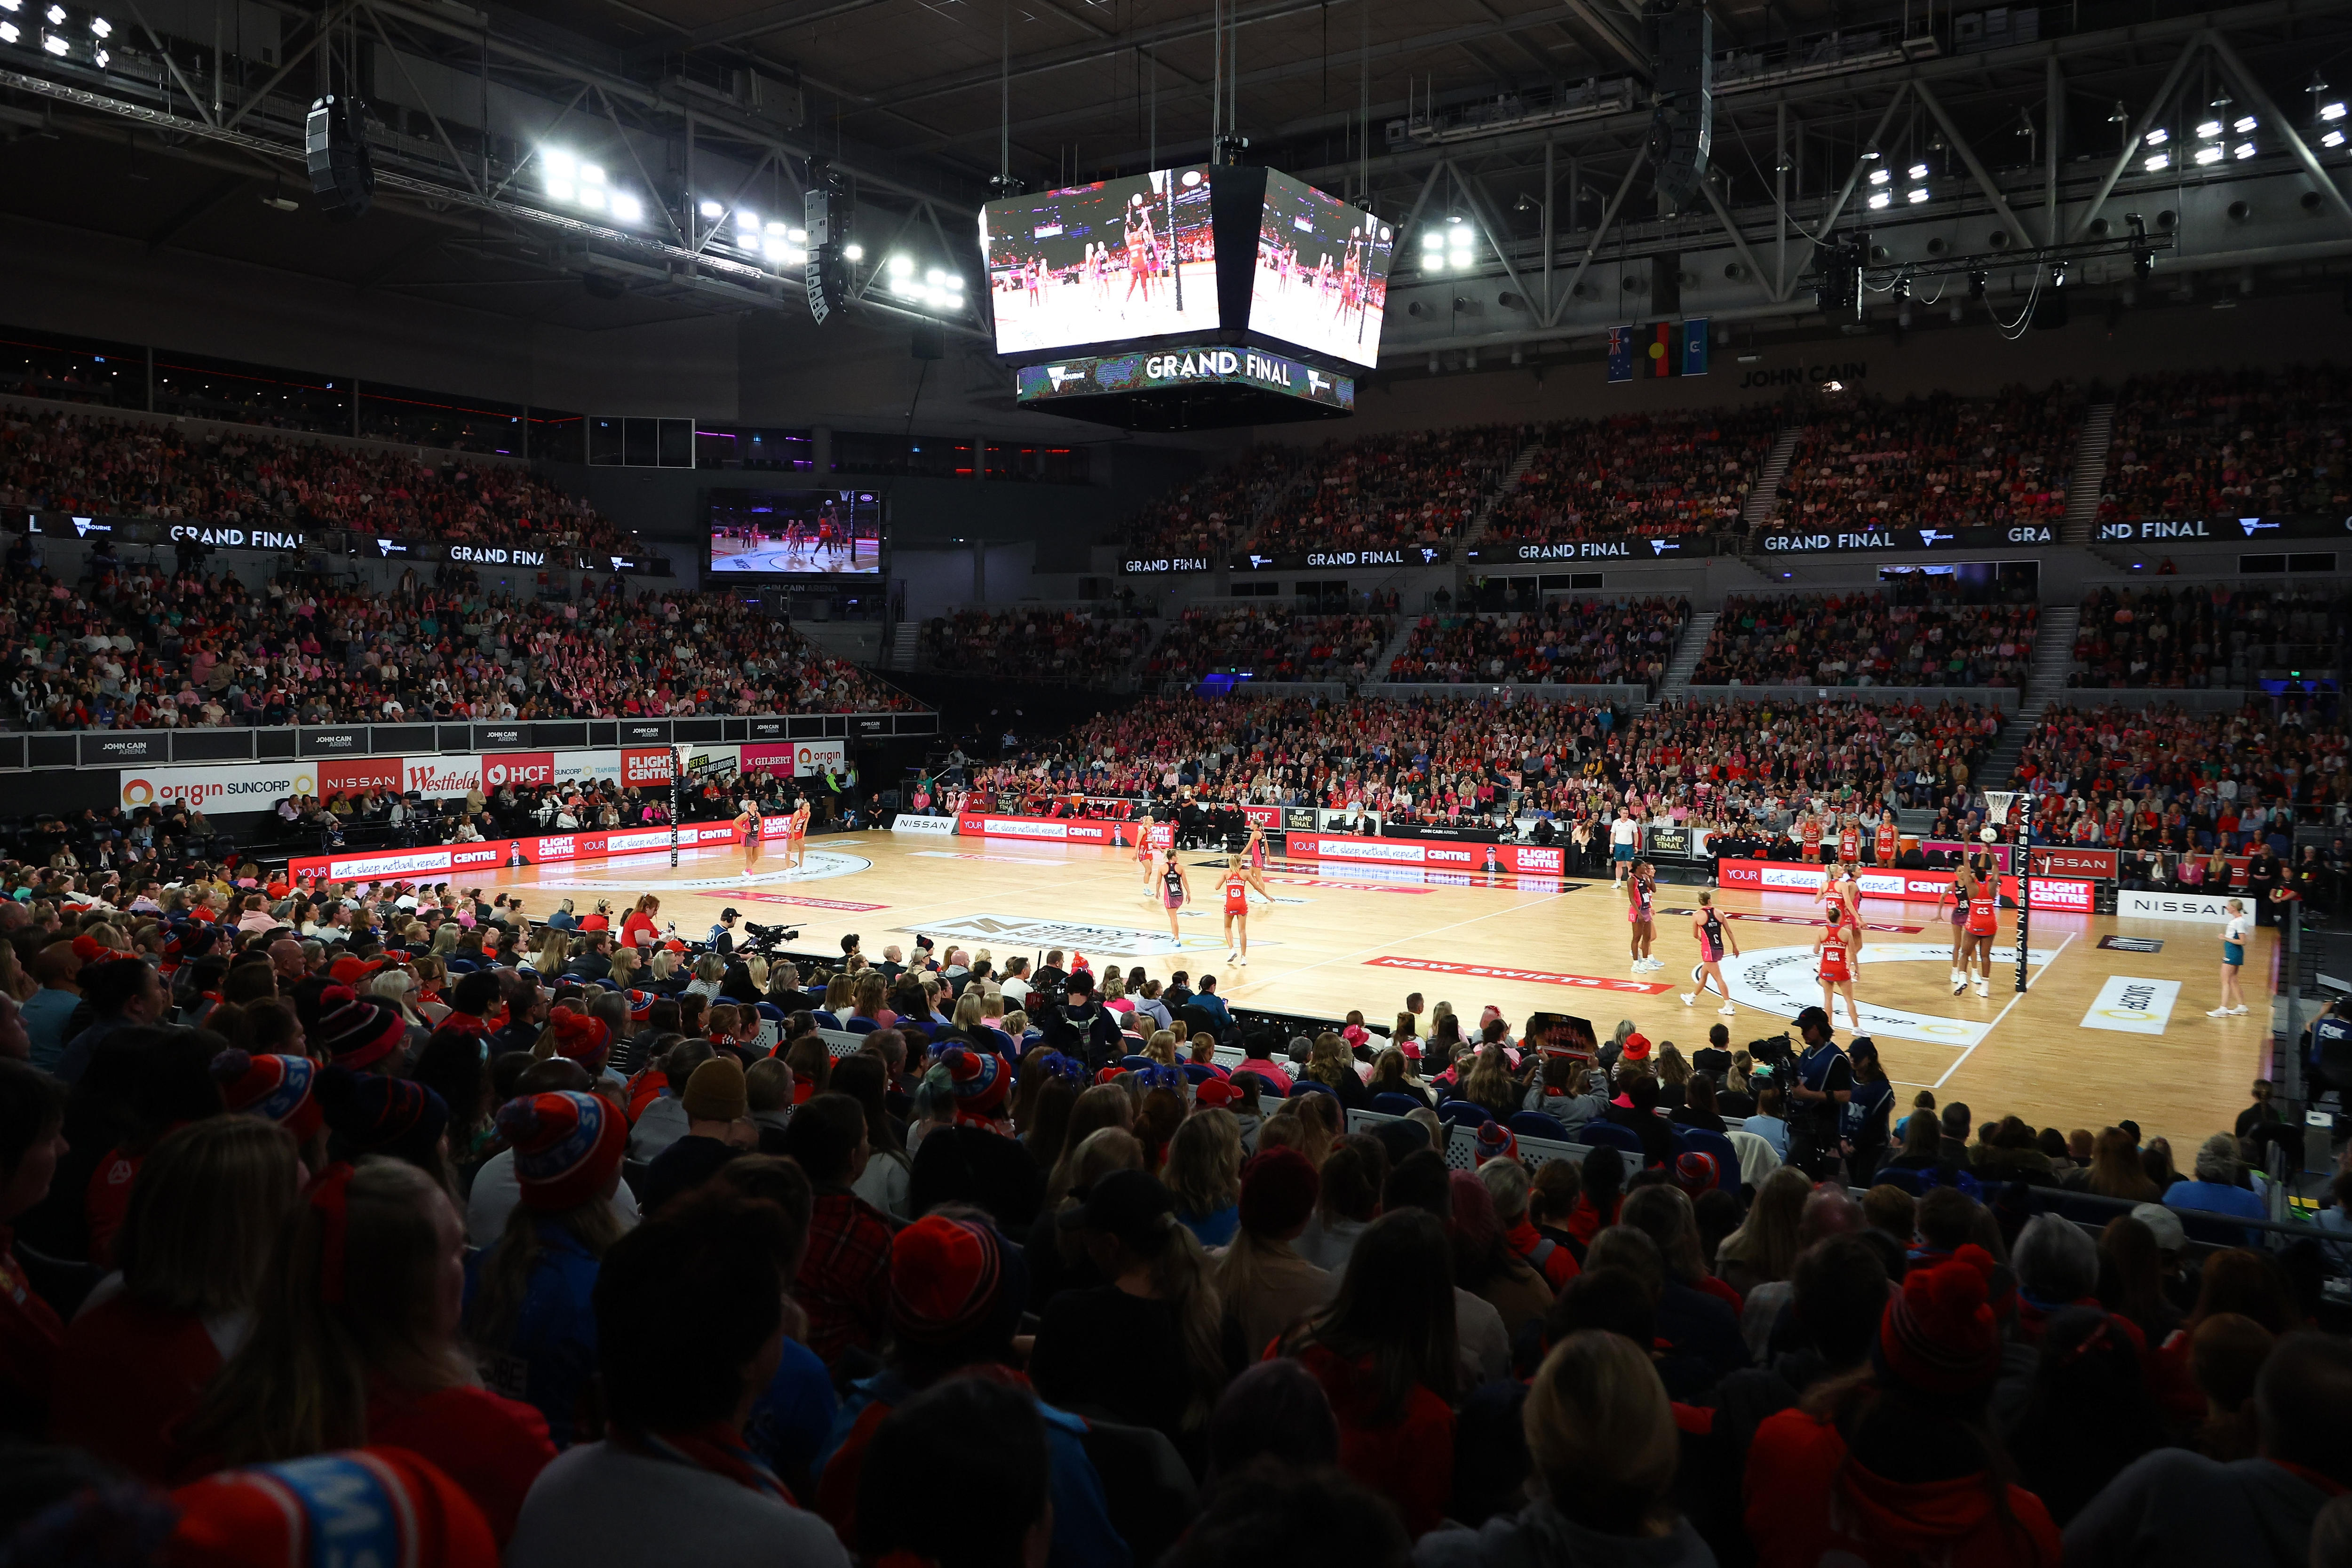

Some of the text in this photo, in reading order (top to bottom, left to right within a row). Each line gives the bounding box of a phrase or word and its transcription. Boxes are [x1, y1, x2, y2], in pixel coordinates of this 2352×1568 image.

[1147, 351, 1290, 387] GRAND FINAL
[1740, 362, 1866, 389] JOHN CAIN
[171, 525, 244, 545] GRAND
[2142, 521, 2209, 538] FINAL
[1764, 532, 1895, 550] GRAND FINAL
[451, 545, 507, 564] GRAND
[1519, 542, 1629, 559] GRAND FINAL
[1307, 550, 1403, 565] GRAND FINAL
[1126, 559, 1168, 572] GRAND
[628, 756, 672, 769] FLIGHT
[689, 756, 707, 768] GET SET
[755, 756, 791, 766] GILBERT
[814, 751, 841, 764] origin
[708, 758, 735, 773] MELBOURNE
[406, 765, 478, 792] Westfield
[510, 765, 549, 782] HCF
[227, 780, 290, 795] SUNCORP
[327, 776, 396, 789] NISSAN
[160, 783, 223, 805] origin
[764, 817, 791, 826] FLIGHT
[1247, 811, 1272, 823] HCF
[764, 824, 788, 834] CENTR
[899, 820, 948, 829] NISSAN
[964, 820, 982, 829] YOUR
[700, 829, 732, 839] CENTRE
[1042, 826, 1064, 837] repeat
[1068, 828, 1102, 837] CENTRE
[2019, 803, 2030, 861] NISSAN
[539, 836, 574, 848] FLIGHT
[583, 839, 605, 850] YOUR
[1293, 841, 1316, 851] YOUR
[1654, 835, 1685, 844] GRAND
[539, 845, 575, 855] CENTRE
[1393, 847, 1422, 861] repeat
[1427, 849, 1471, 862] CENTRE
[1517, 848, 1557, 860] FLIGHT
[417, 855, 447, 872] repeat
[453, 851, 496, 864] CENTRE
[1517, 858, 1559, 868] CENTRE
[2034, 857, 2107, 868] NISSAN
[297, 867, 327, 877] YOUR
[1727, 869, 1757, 880] YOUR
[1311, 882, 1400, 891] HCF
[1862, 877, 1899, 894] repeat
[1907, 881, 1952, 893] CENT
[2030, 882, 2085, 894] FLIGHT
[1231, 889, 1241, 897] GD
[2017, 867, 2026, 923] NISSAN
[2029, 892, 2088, 904] CENTRE
[1029, 928, 1124, 941] SUPER
[1043, 924, 1174, 939] SUNCORP
[1003, 931, 1137, 948] NETBALL
[2015, 930, 2024, 986] NISSAN
[1381, 958, 1602, 986] NSW SWIFTS
[2118, 985, 2156, 1010] SUNCORP
